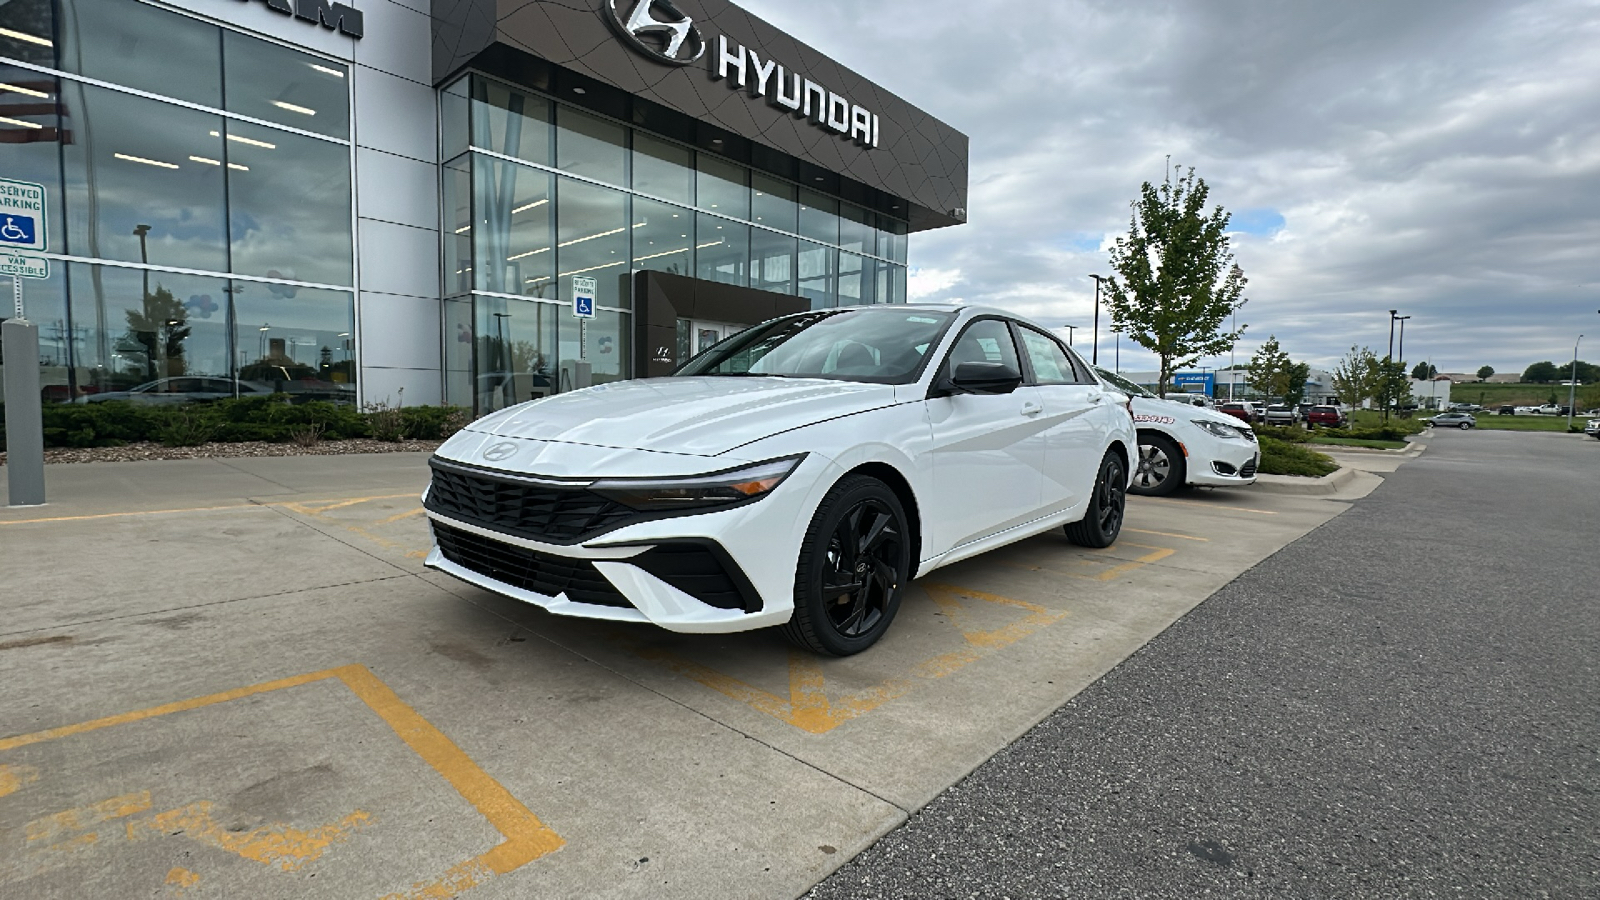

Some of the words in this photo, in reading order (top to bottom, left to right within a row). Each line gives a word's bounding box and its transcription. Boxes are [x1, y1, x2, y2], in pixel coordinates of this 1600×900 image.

[715, 34, 879, 148] HYUNDAI
[0, 185, 39, 199] SERVED
[8, 257, 26, 266] VAN
[0, 264, 45, 275] CESSIBLE
